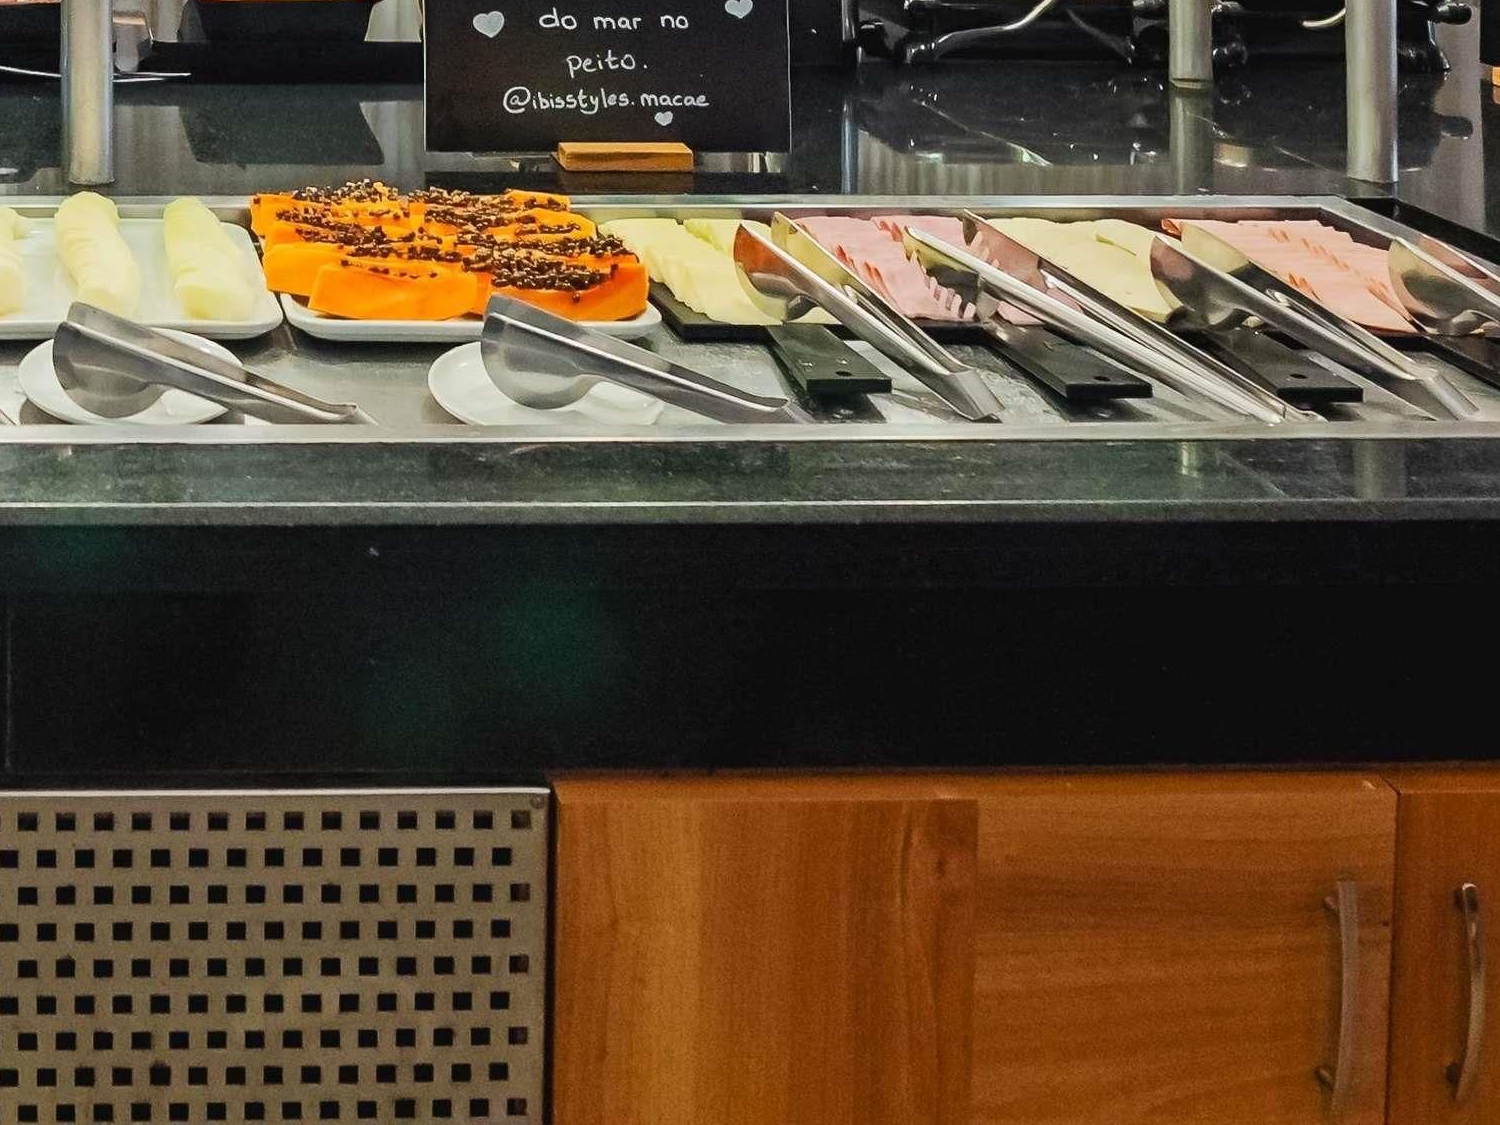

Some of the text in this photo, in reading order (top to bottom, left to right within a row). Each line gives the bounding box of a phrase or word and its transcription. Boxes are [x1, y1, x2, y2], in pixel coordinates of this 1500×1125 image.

[538, 6, 690, 31] do mar no
[566, 49, 649, 79] peito.
[502, 85, 710, 116] @ibisstyles.macae
